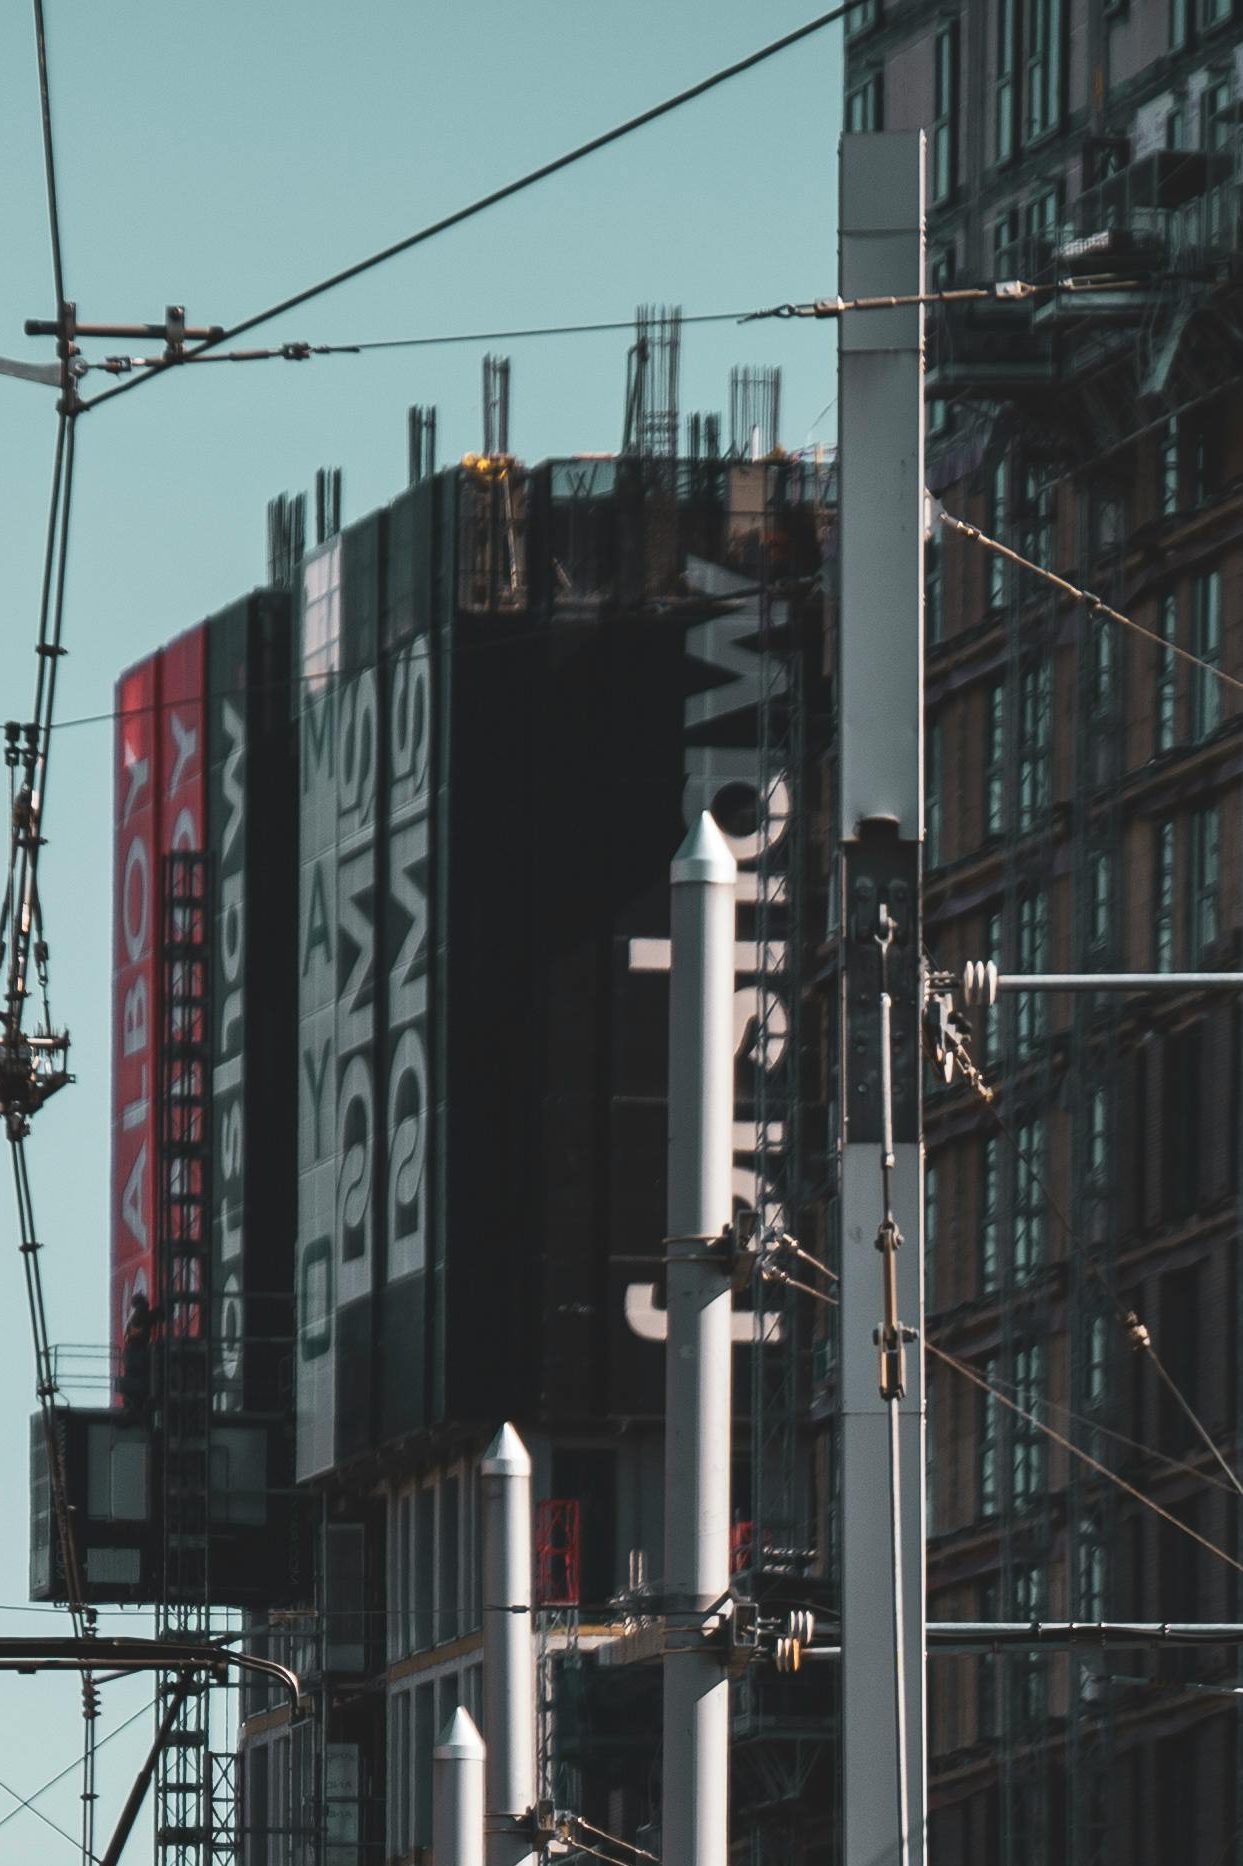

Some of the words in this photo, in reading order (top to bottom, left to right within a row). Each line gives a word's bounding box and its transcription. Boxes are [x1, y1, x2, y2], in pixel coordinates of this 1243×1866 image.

[121, 738, 148, 1342] SALBOY
[213, 699, 245, 1411] orshaw
[336, 664, 376, 1309] DOMIS
[387, 633, 429, 1283] DOMIS
